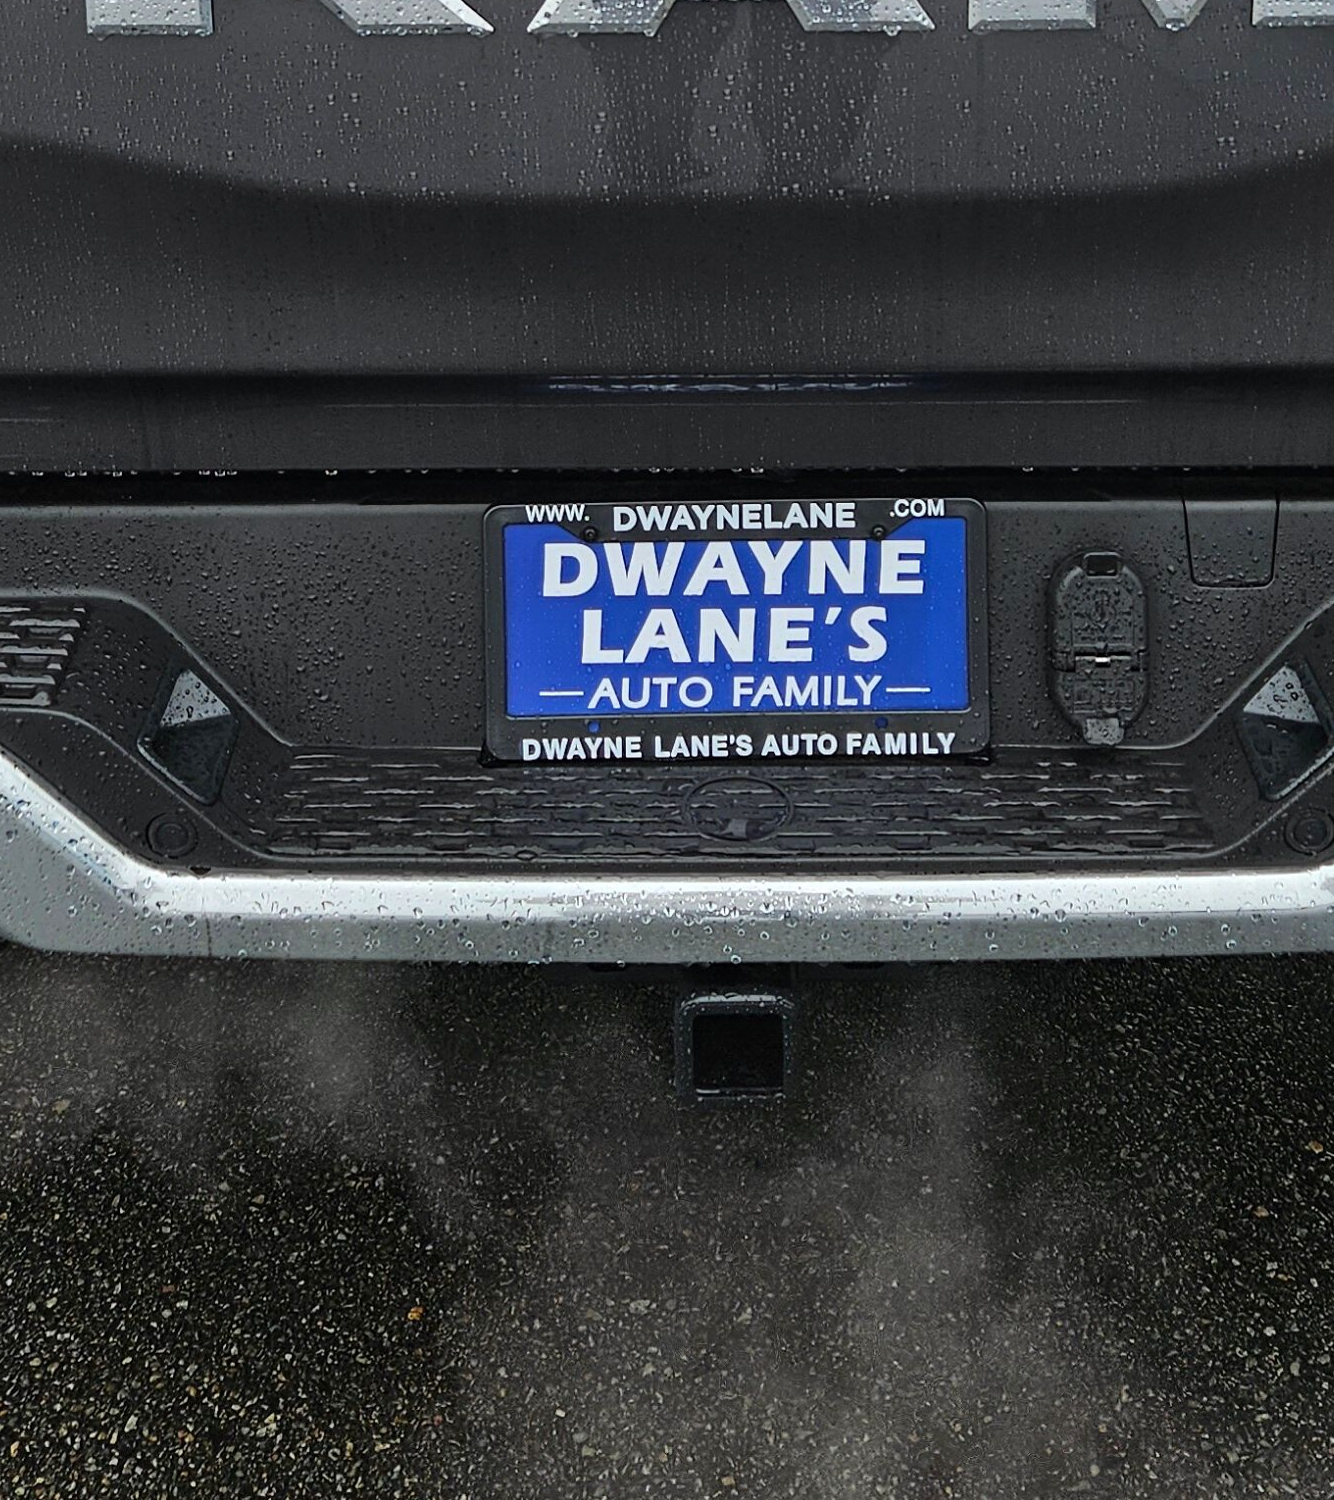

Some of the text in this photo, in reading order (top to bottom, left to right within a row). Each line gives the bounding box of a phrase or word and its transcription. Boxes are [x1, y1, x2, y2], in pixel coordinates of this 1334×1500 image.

[613, 502, 856, 532] DWAYNELANE
[889, 499, 945, 518] .COM
[542, 539, 926, 597] DWAYNE
[581, 606, 888, 664] LANE'S
[587, 675, 883, 709] AUTO FAMILY
[522, 732, 956, 761] DWAYNE LANE'S AUTO FAMILY
